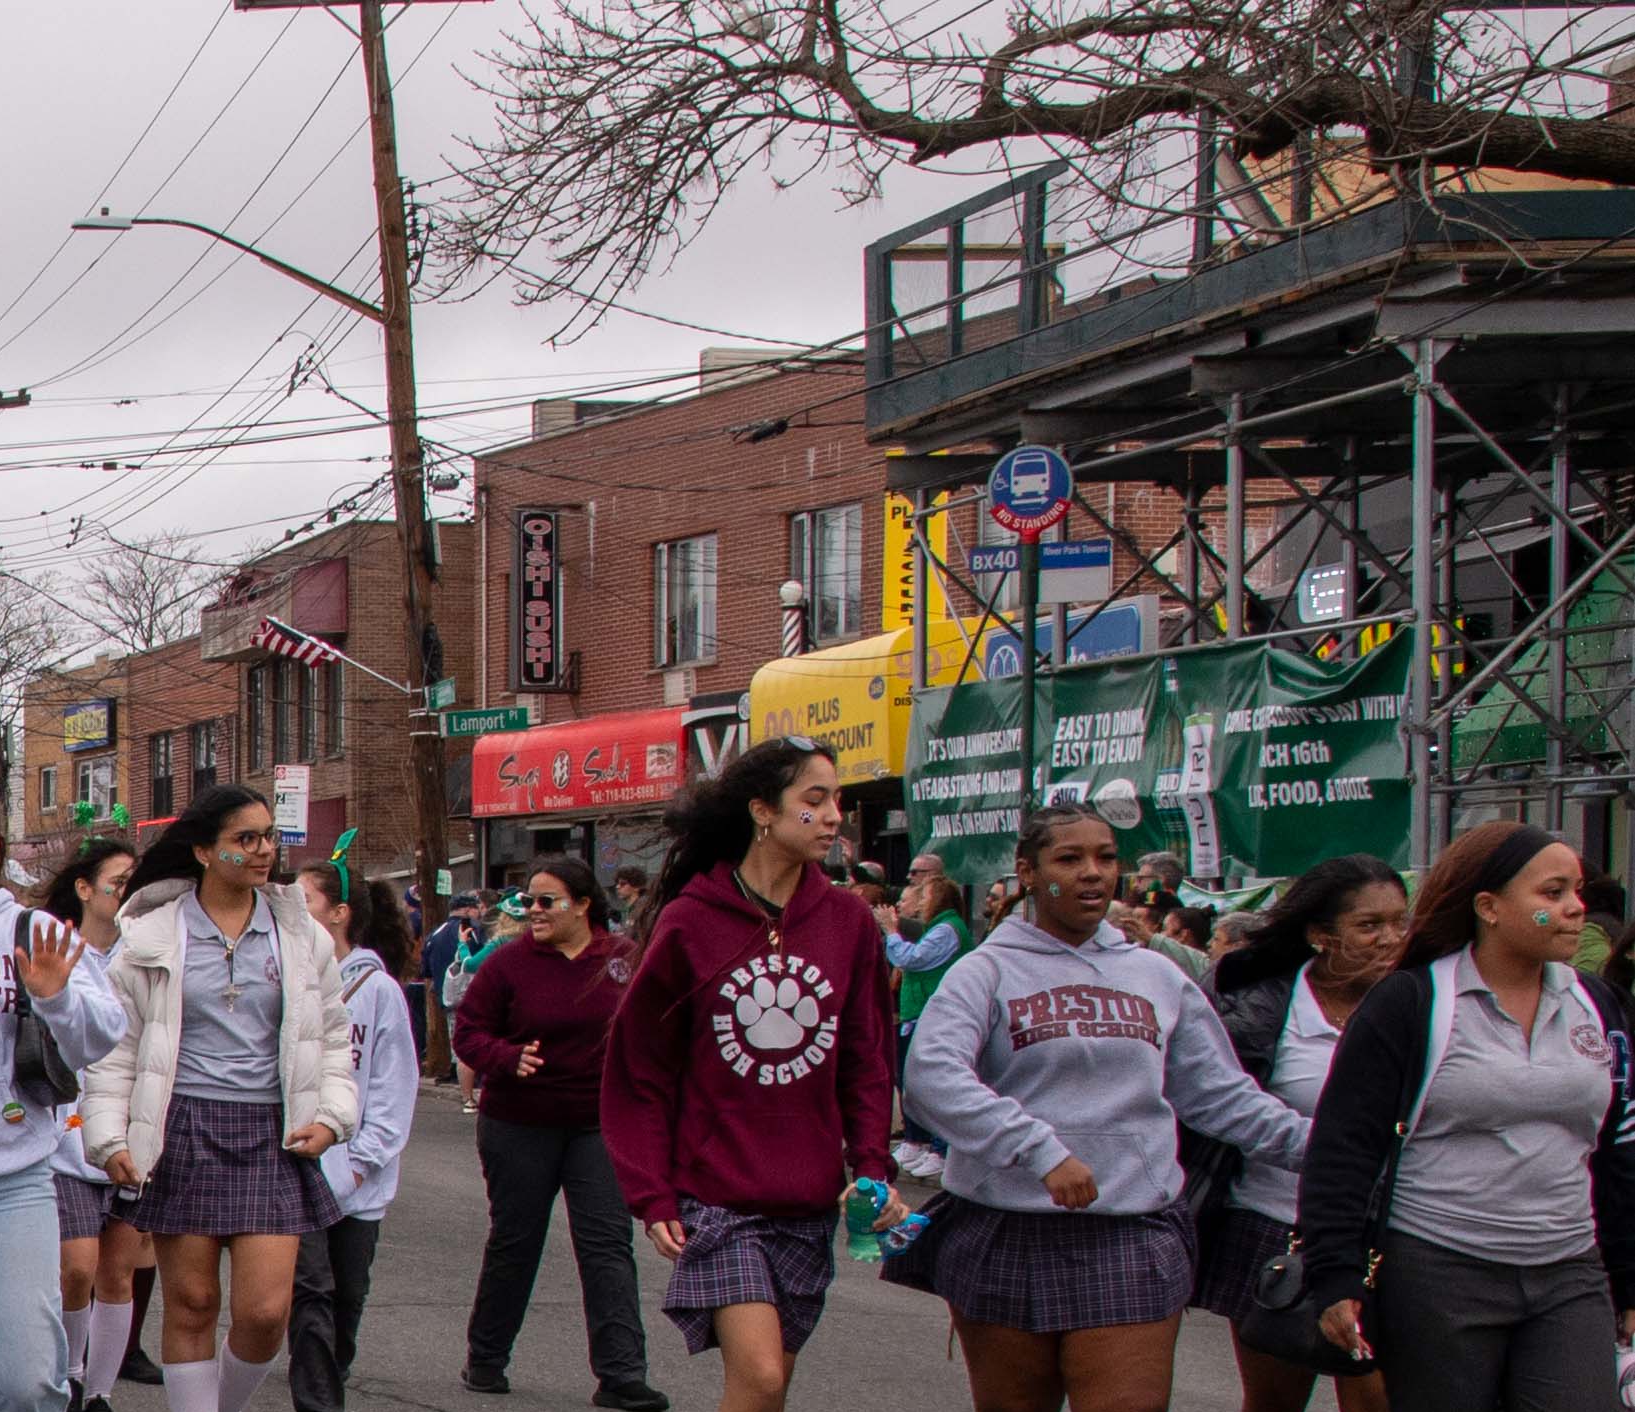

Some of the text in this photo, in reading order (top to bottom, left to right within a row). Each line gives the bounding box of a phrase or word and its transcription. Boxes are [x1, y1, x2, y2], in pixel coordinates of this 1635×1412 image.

[996, 501, 1065, 529] NO STANDING
[524, 519, 552, 597] OISHI
[973, 551, 1017, 571] BX40
[525, 600, 551, 678] SUSHI
[452, 710, 518, 734] Lamport Pl
[807, 698, 839, 727] PLUS
[1055, 707, 1146, 742] EASY TO DRINK
[1329, 700, 1358, 723] DAY
[1360, 696, 1396, 720] WITH
[928, 739, 946, 762] IT'S
[946, 736, 964, 760] OUR
[1052, 735, 1144, 767] EASY TO ENJOY
[1291, 740, 1332, 765] 16th
[921, 776, 949, 800] YEARS
[982, 770, 999, 794] AND
[1269, 780, 1323, 807] FOOD,
[1335, 777, 1372, 800] BOOZE
[931, 814, 951, 838] JOIN
[719, 954, 834, 1003] PRESTON
[1007, 984, 1162, 1033] PRESTON
[713, 1013, 756, 1077] HIGH
[758, 1015, 839, 1086] SCHOOL
[1011, 1021, 1162, 1052] HIGH SCHOOL
